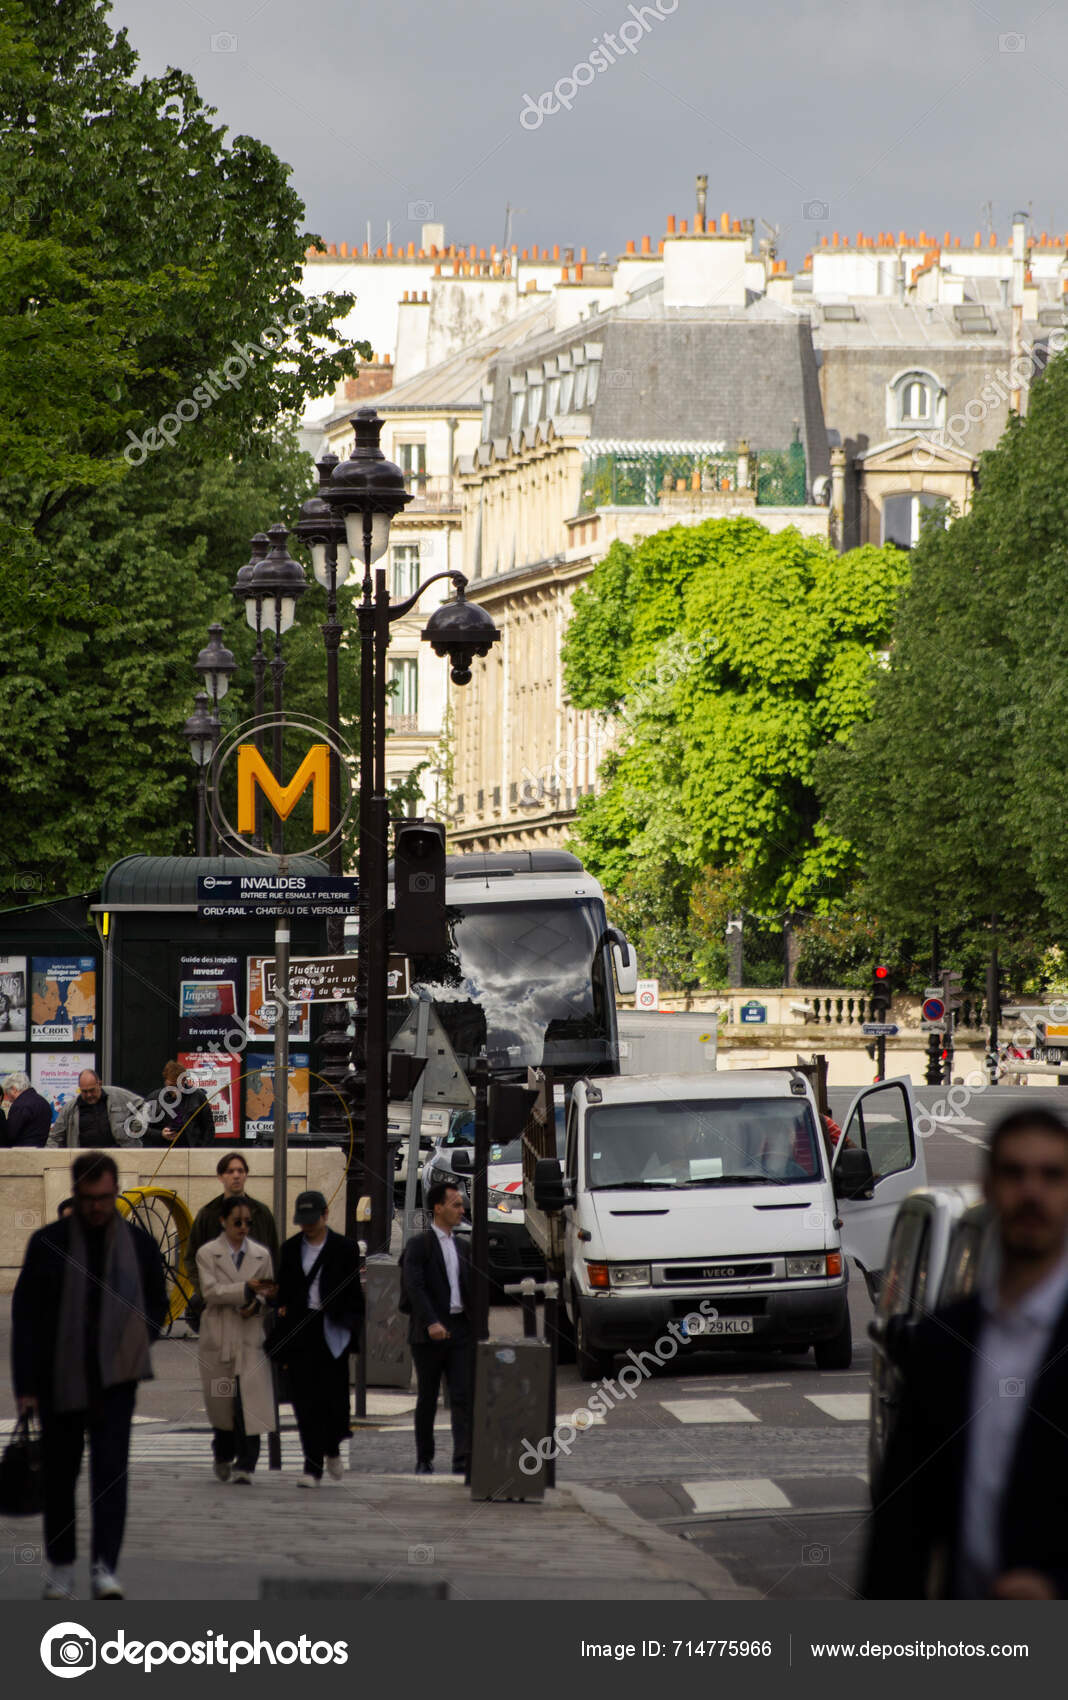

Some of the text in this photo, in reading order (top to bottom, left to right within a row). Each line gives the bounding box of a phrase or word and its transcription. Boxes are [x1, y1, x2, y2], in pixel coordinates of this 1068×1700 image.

[238, 744, 330, 834] M
[240, 877, 306, 889] INVALIDES
[203, 907, 247, 915] ORLY-RAIL
[256, 907, 295, 915] CHATEAU
[311, 906, 360, 914] VERSAILLES
[288, 965, 335, 975] Fluctuart
[319, 976, 339, 985] d'art
[257, 1122, 274, 1130] CRO
[702, 1268, 735, 1277] IVECO
[709, 1321, 723, 1333] 29
[725, 1320, 750, 1333] KLO
